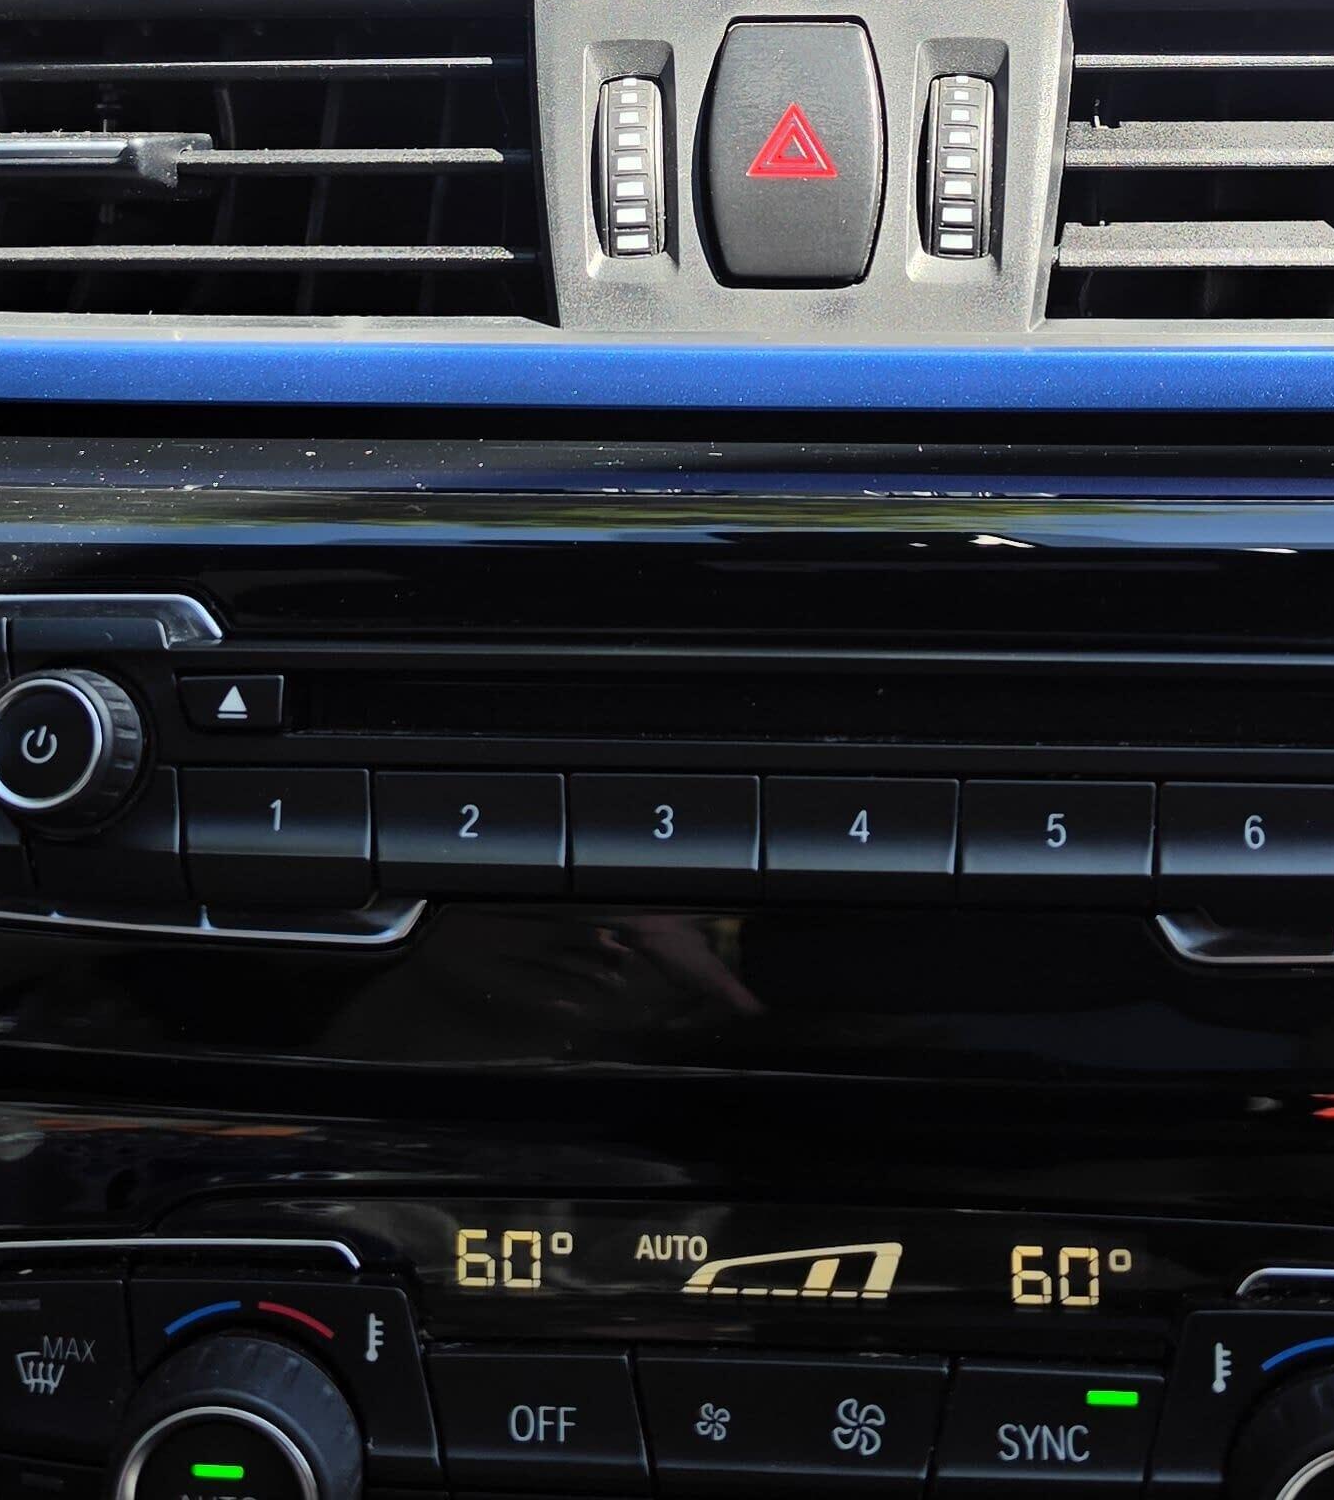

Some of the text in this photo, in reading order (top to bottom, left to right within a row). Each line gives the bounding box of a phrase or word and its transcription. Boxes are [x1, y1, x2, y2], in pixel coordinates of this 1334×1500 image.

[269, 798, 283, 833] 1
[458, 803, 480, 839] 2
[652, 805, 674, 840] 3
[847, 810, 871, 844] 4
[1045, 813, 1067, 849] 5
[1243, 815, 1266, 850] 6
[634, 1234, 709, 1263] AUTO
[41, 1333, 96, 1364] MAX
[509, 1404, 577, 1444] OFF
[996, 1423, 1090, 1463] SYNC
